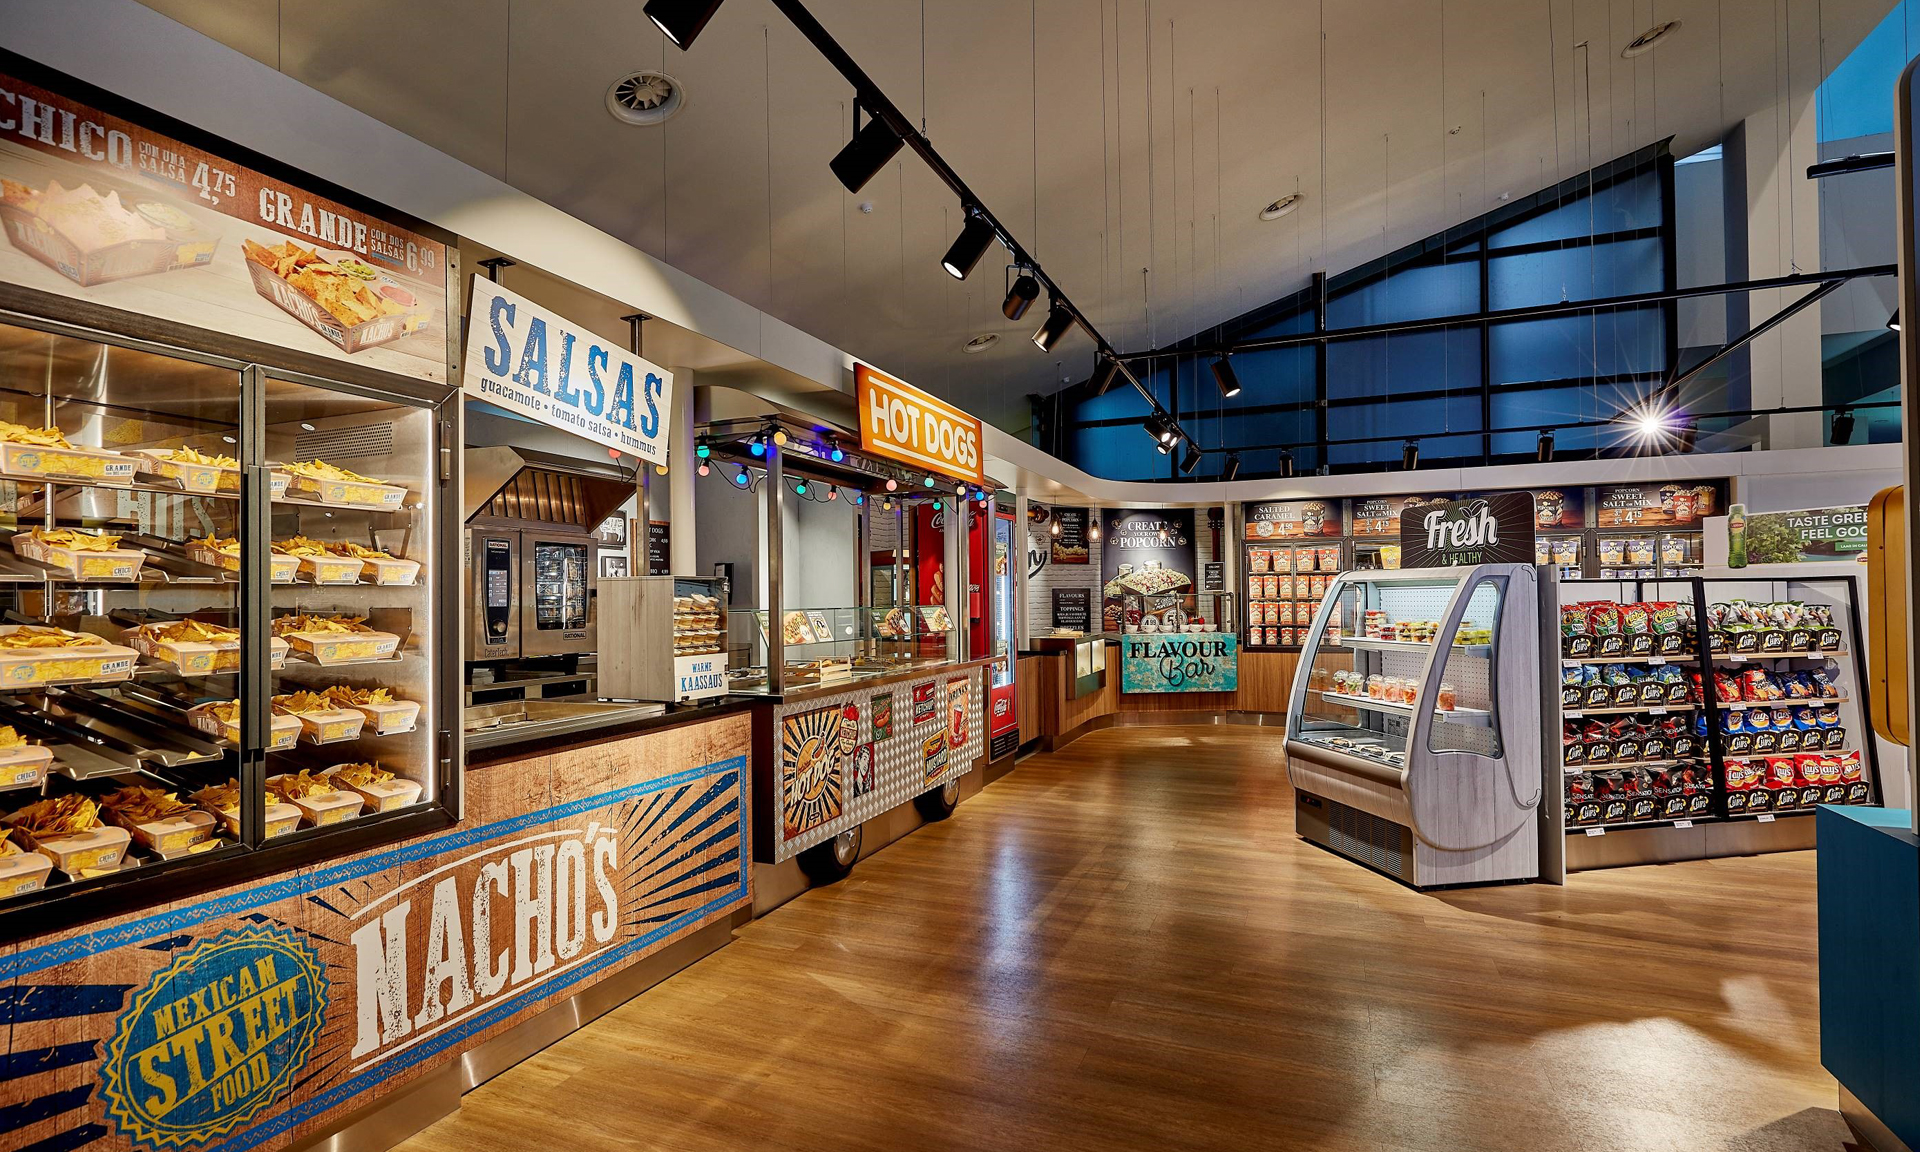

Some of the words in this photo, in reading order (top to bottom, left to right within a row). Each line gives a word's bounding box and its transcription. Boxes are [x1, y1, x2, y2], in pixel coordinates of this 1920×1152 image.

[0, 87, 133, 170] CHICO
[138, 141, 160, 160] CON
[162, 147, 186, 169] UNA
[139, 153, 187, 184] SALSA
[191, 162, 236, 206] 4,75
[259, 187, 368, 255] GRANDE
[370, 228, 387, 243] CON
[388, 234, 404, 249] DOS
[370, 240, 404, 262] SALSAS
[484, 296, 663, 439] SALSAS
[551, 404, 586, 428] tomato
[588, 420, 612, 439] salsa
[620, 431, 657, 456] hummus
[869, 388, 921, 448] HOT
[924, 413, 978, 469] DOGS
[105, 464, 132, 472] GRANDE
[1258, 505, 1291, 514] SALTED
[1602, 500, 1626, 508] SALT
[1633, 499, 1653, 507] MIX
[1128, 521, 1168, 531] CREATE
[1254, 512, 1296, 521] CARAMEL
[1787, 515, 1829, 529] TASTE
[1424, 506, 1498, 550] Fresh
[1801, 528, 1833, 540] FEEL
[1120, 536, 1176, 548] POPCORN
[1441, 553, 1448, 565] &
[1449, 551, 1483, 565] HEALTHY
[114, 567, 132, 575] CHICO
[1129, 641, 1229, 660] FLAVOUR
[102, 660, 129, 671] GRANDE
[691, 661, 712, 674] WARME
[1159, 651, 1215, 687] Bar
[681, 674, 723, 692] KAASSAUS
[926, 748, 948, 775] MUSTARD
[16, 770, 37, 780] CHICO
[791, 766, 815, 808] HOT
[813, 748, 836, 789] DOG
[350, 822, 619, 1060] NACHO'S
[152, 953, 279, 1041] MEXICAN
[137, 979, 303, 1118] STREET
[210, 1050, 271, 1113] FOOD
